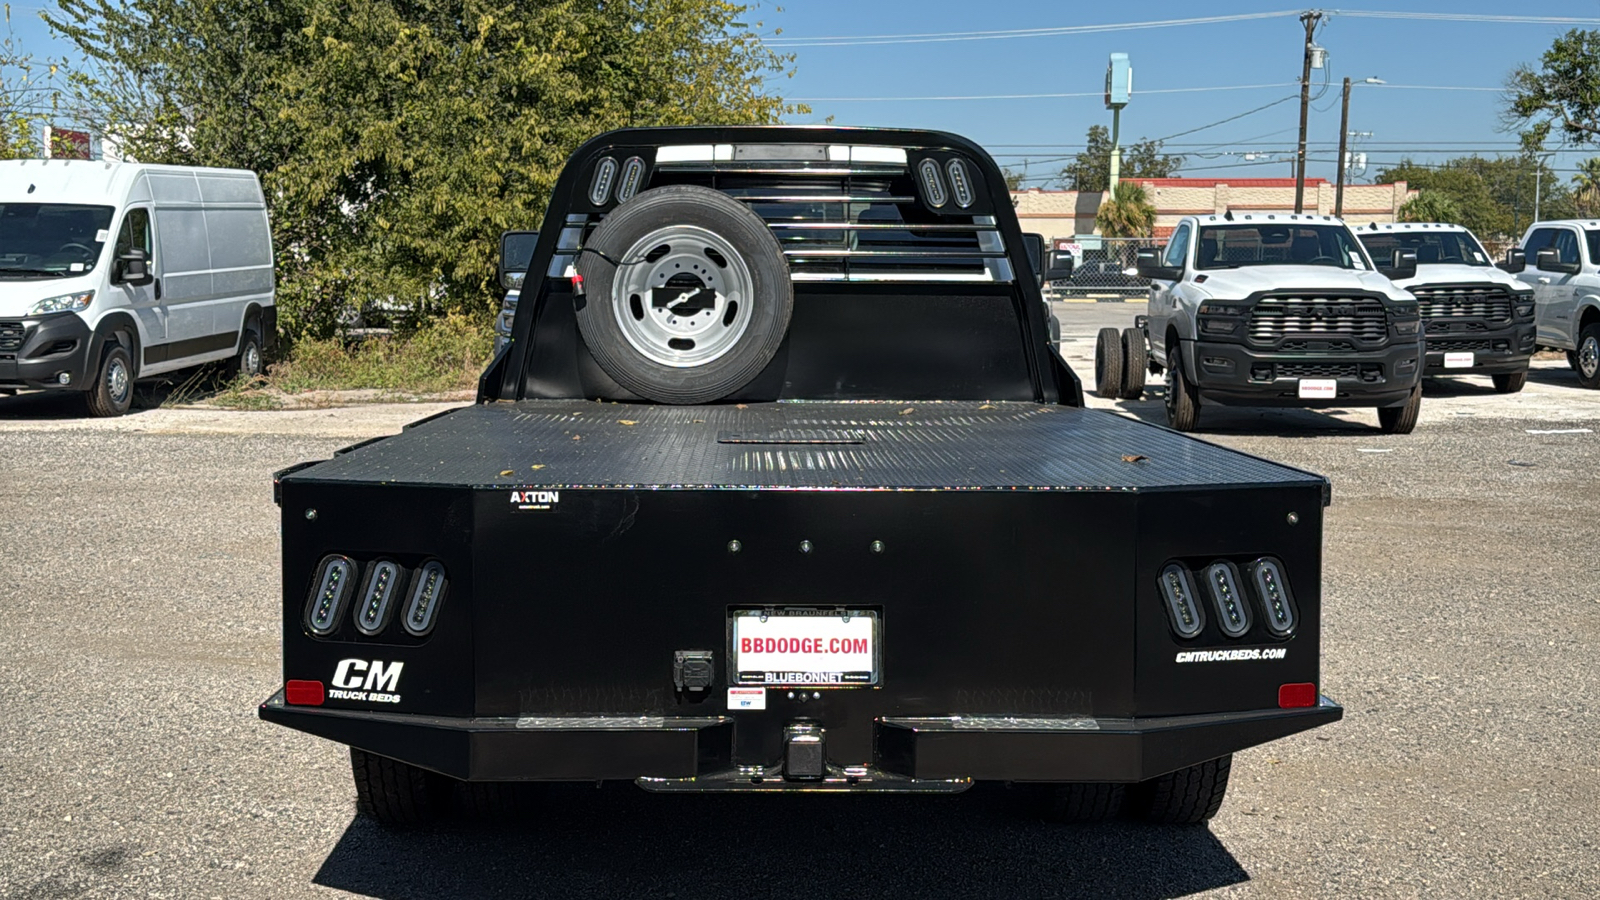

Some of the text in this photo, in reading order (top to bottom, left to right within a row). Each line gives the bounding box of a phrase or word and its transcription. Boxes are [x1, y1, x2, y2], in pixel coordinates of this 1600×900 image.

[1284, 304, 1355, 316] RAM
[510, 491, 559, 503] AXTON
[741, 637, 868, 654] BBDODGE.COM
[1175, 648, 1287, 663] CMTRUCKBEDS.COM
[331, 658, 404, 691] CM
[764, 672, 844, 683] BLUEBONNET
[328, 689, 401, 703] TRUCK BEDS
